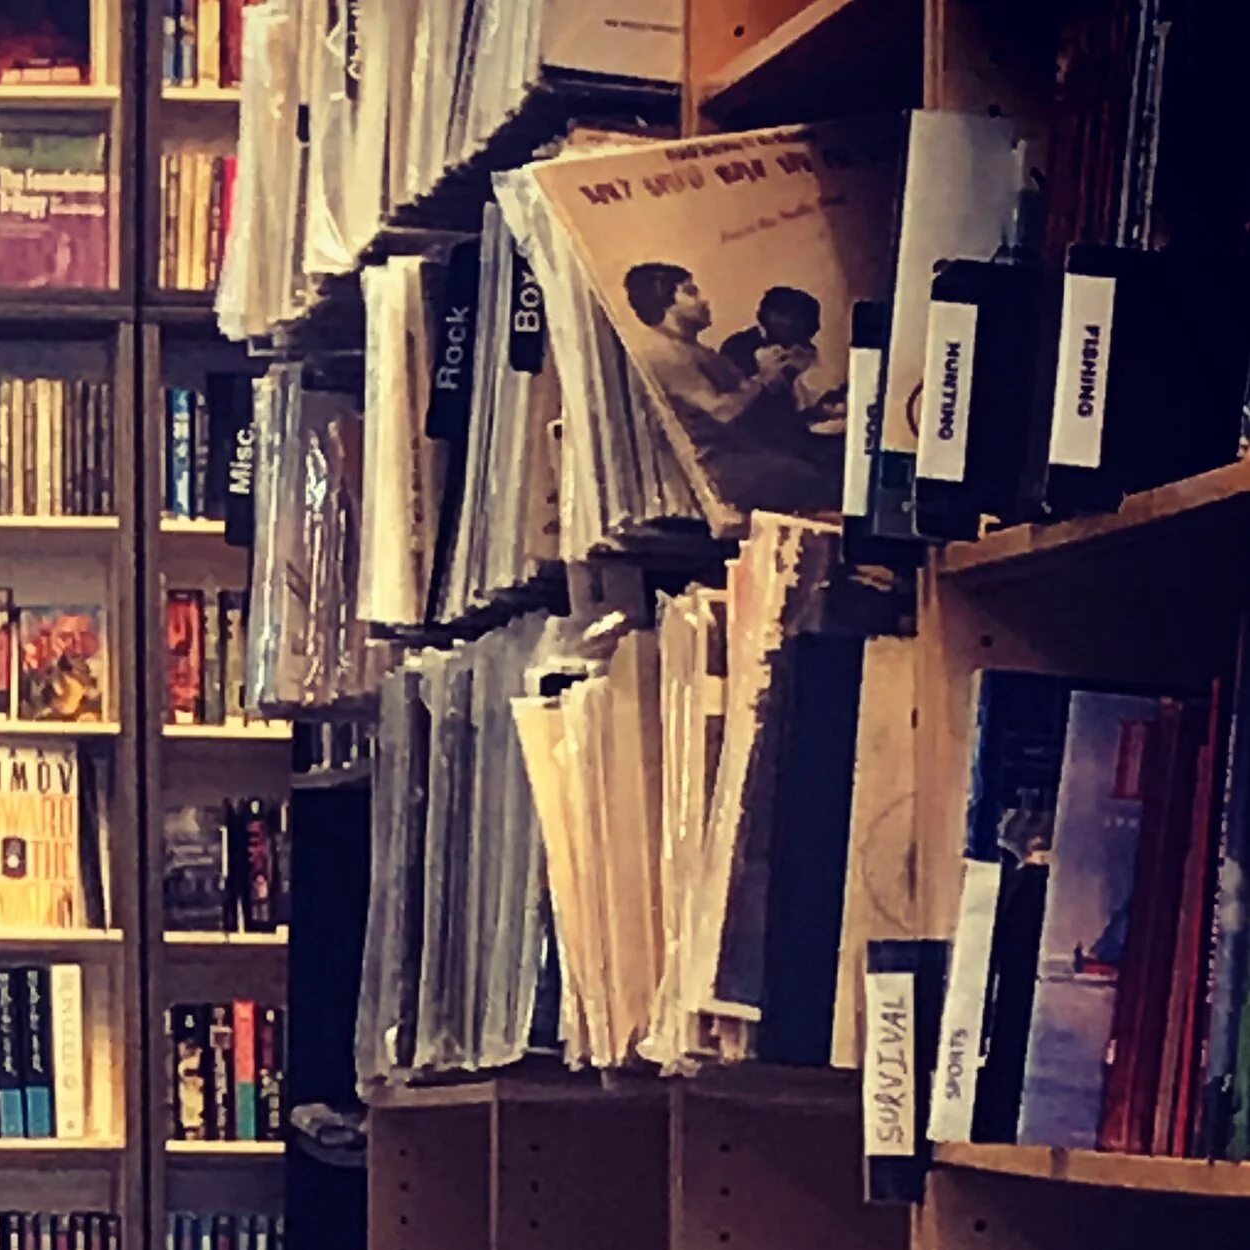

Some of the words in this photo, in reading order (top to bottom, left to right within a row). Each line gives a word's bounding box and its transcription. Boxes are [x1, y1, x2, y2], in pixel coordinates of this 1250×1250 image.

[436, 306, 469, 391] Rock
[937, 340, 961, 441] HUNTING
[1076, 325, 1100, 417] FISHING
[876, 995, 906, 1144] SURVIVAL
[945, 1027, 968, 1099] SPORTS
